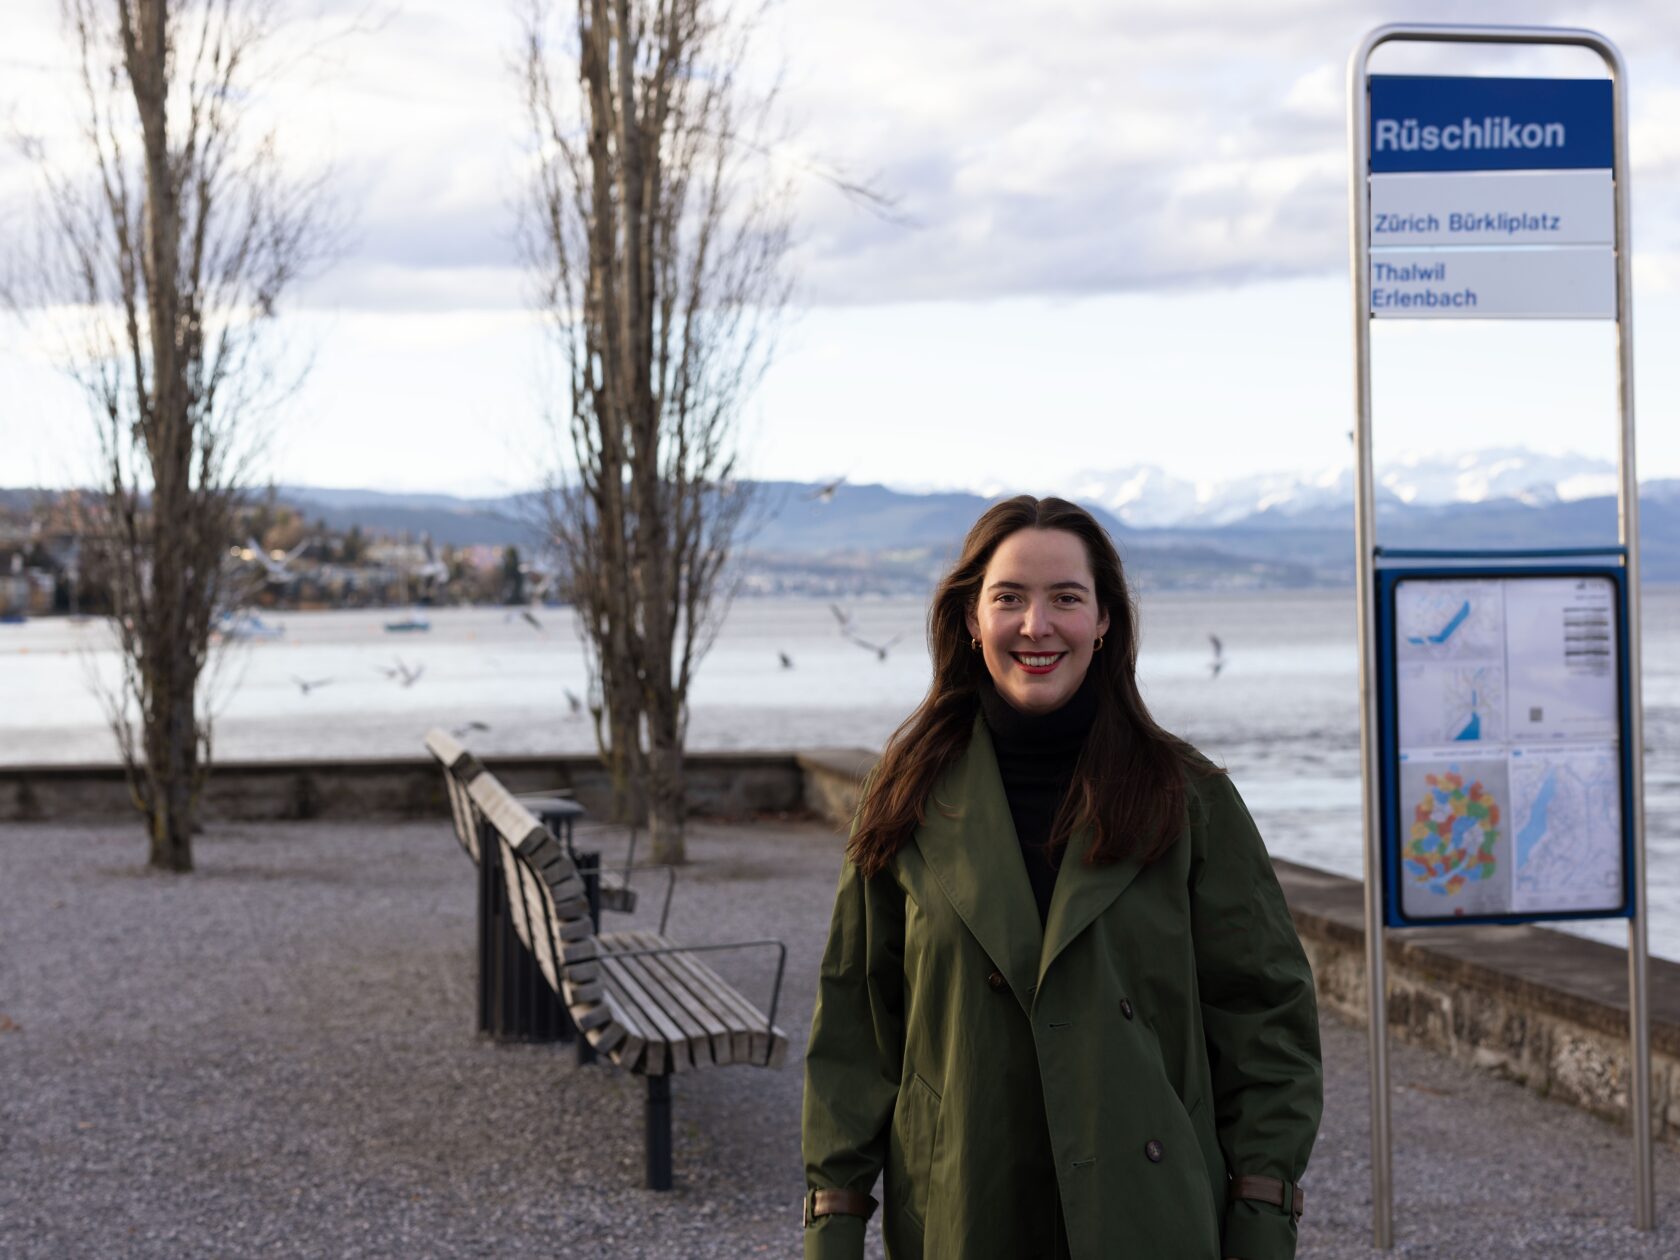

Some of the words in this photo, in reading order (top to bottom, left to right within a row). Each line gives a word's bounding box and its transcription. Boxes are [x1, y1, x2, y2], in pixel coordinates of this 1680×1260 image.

[1375, 117, 1565, 151] Rüschlikon
[1375, 213, 1439, 233] Zürich
[1449, 212, 1560, 235] Bürkliplatz
[1374, 263, 1445, 281] Thalwil
[1372, 288, 1477, 307] Erlenbach
